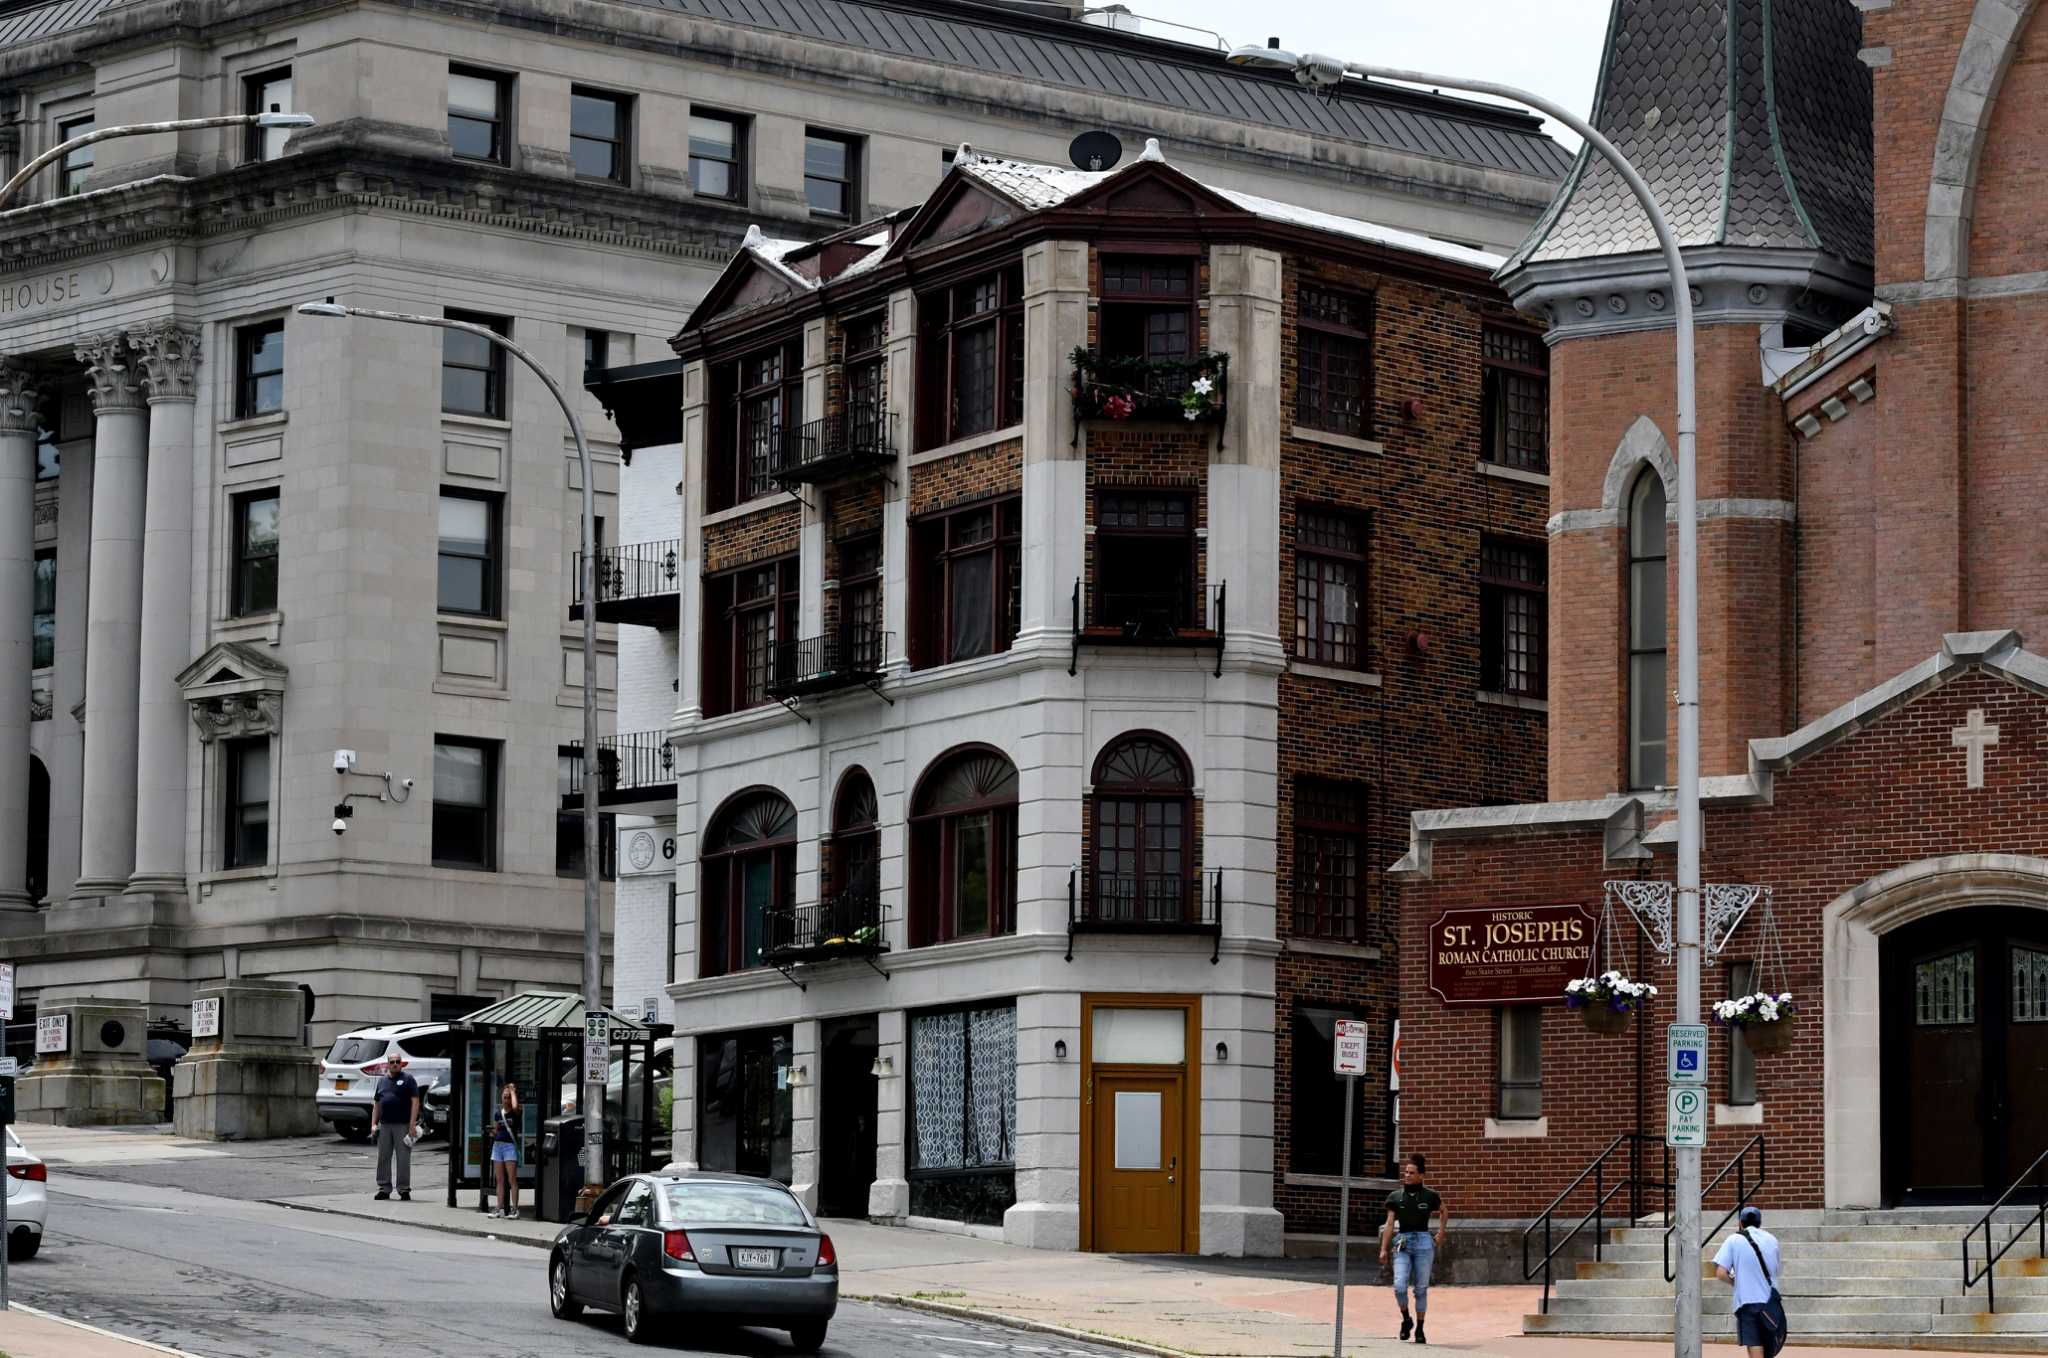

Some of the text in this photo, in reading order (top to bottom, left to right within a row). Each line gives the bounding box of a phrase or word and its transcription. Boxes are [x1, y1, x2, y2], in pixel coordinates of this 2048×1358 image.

[2, 273, 80, 312] HOUSE
[662, 838, 677, 860] 6
[1492, 911, 1534, 922] HISTORIC
[1443, 917, 1584, 949] ST. JOSEPH'S
[1438, 946, 1590, 965] ROMAN CATHOLIC CHURCH
[1478, 966, 1494, 976] State
[1494, 965, 1513, 975] Street
[1519, 964, 1546, 974] Founded
[193, 999, 217, 1013] EXIT ONLY
[40, 1016, 65, 1030] EXIT ONLY
[612, 1030, 645, 1040] CDTA
[1671, 1029, 1705, 1038] RESERVED
[592, 1047, 602, 1055] NO
[1682, 1095, 1693, 1110] P
[1679, 1115, 1693, 1123] PAY
[1672, 1125, 1700, 1133] PARKING
